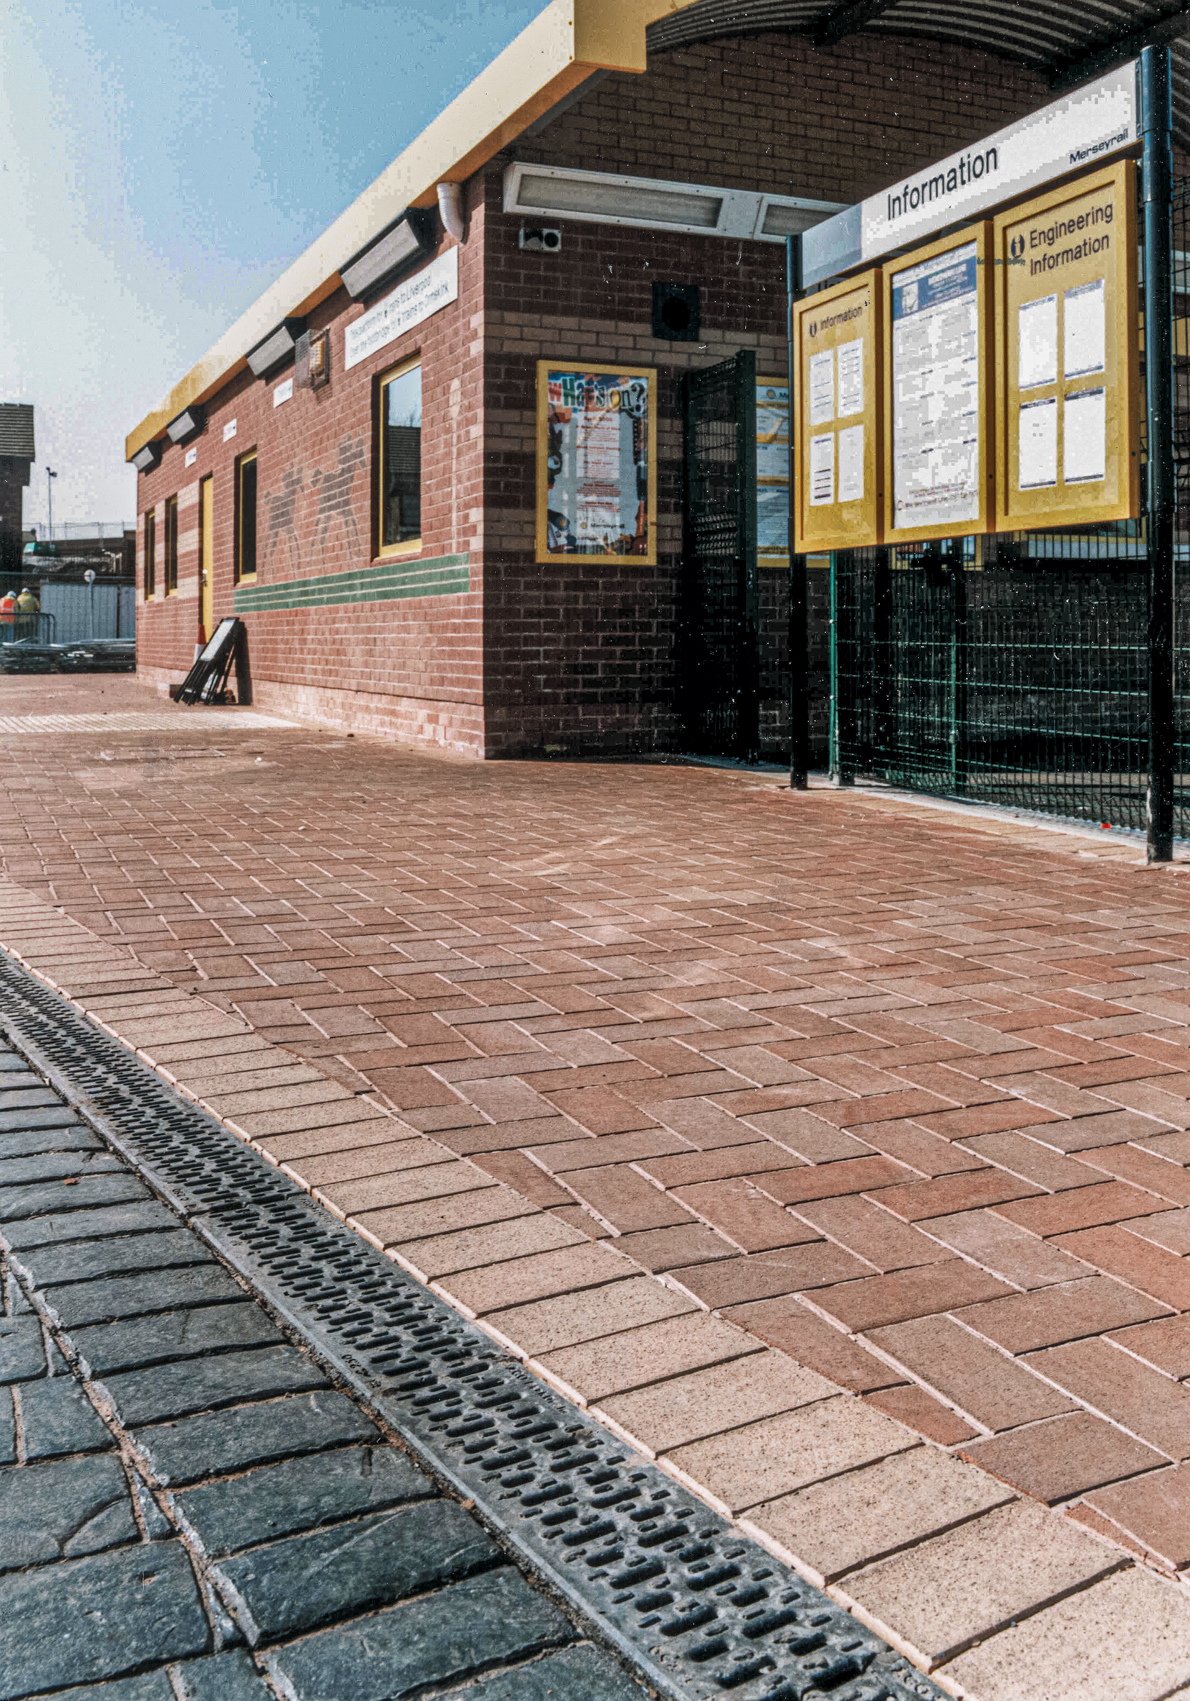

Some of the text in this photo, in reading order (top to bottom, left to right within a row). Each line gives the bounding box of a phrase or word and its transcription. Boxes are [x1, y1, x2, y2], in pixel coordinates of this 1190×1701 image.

[1069, 128, 1129, 164] Merseyrail
[887, 147, 999, 221] Information
[1029, 201, 1114, 249] Engineering
[1029, 233, 1110, 276] Information
[406, 275, 431, 301] Liverpool
[820, 306, 862, 331] Information
[609, 382, 647, 414] on?
